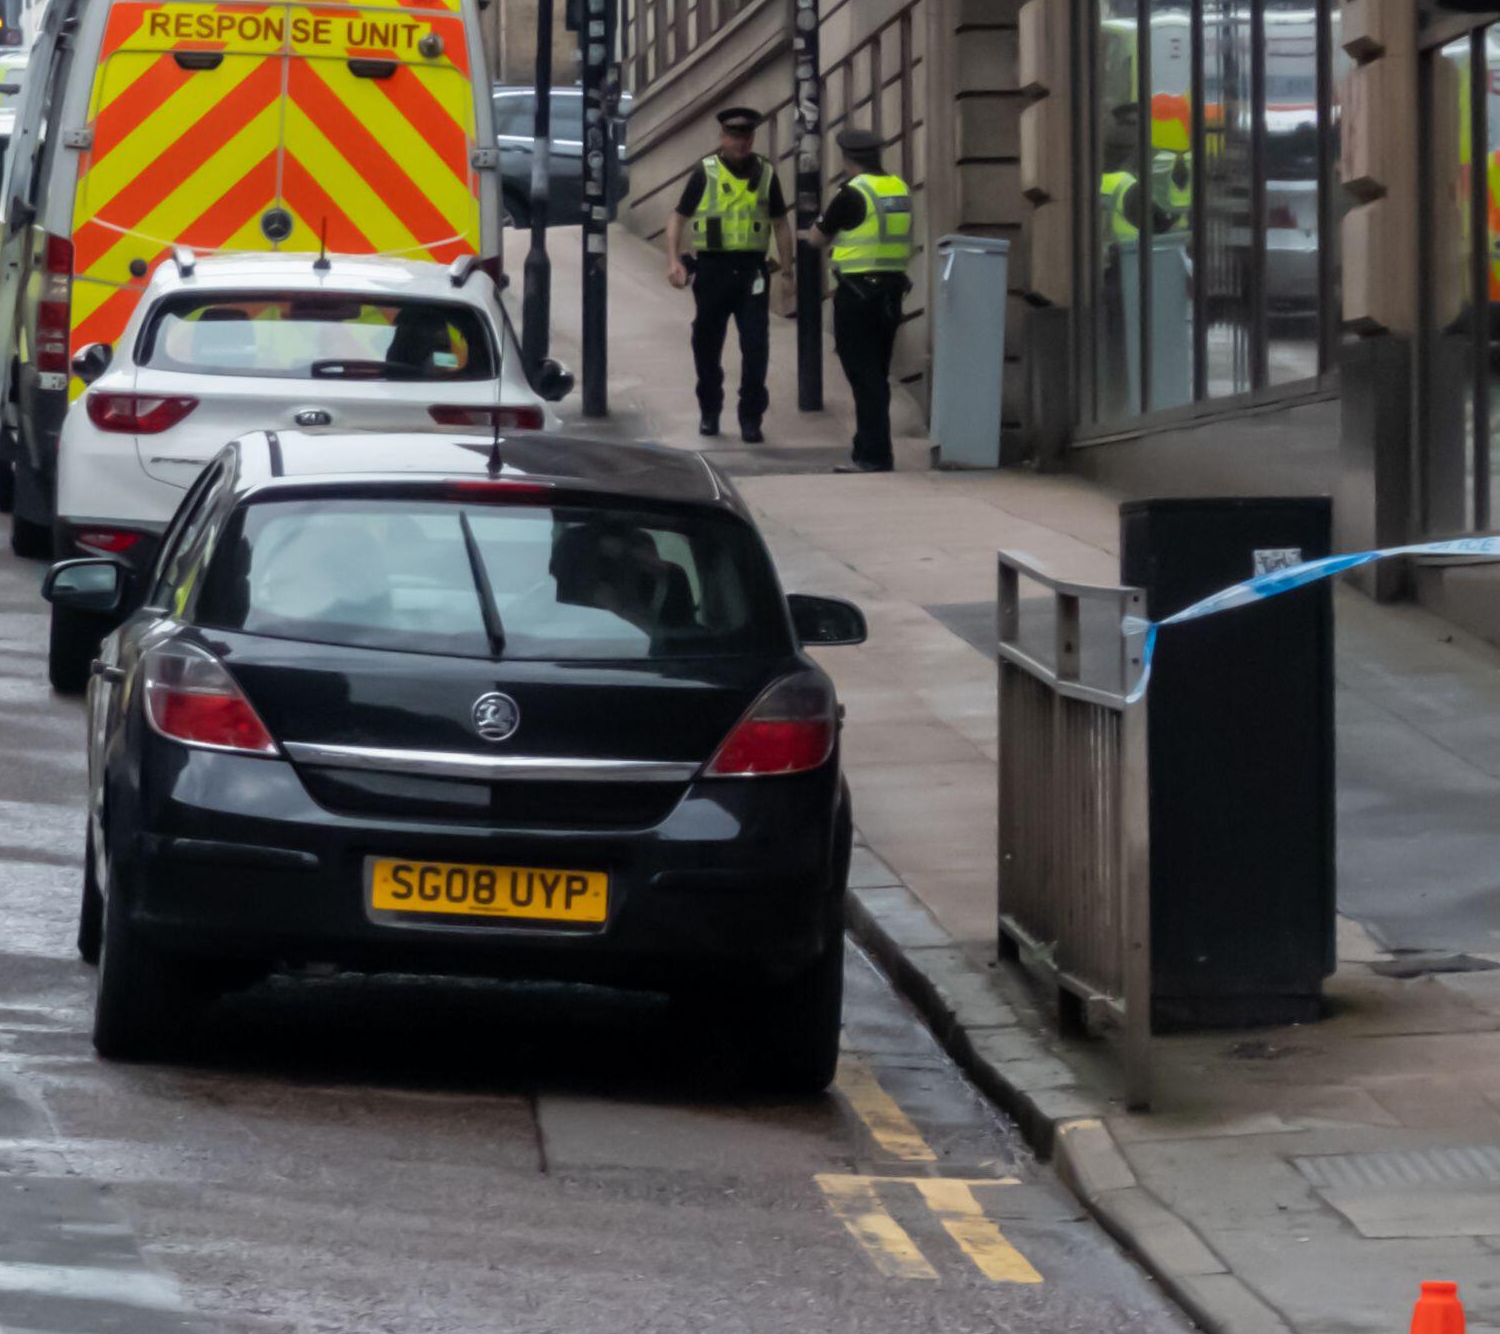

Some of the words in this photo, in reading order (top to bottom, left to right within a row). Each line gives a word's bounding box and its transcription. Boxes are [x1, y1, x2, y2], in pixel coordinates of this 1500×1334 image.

[149, 12, 332, 45] RESPONSE
[347, 22, 421, 49] UNIT
[390, 864, 497, 905] SG08
[510, 870, 589, 911] UYP
